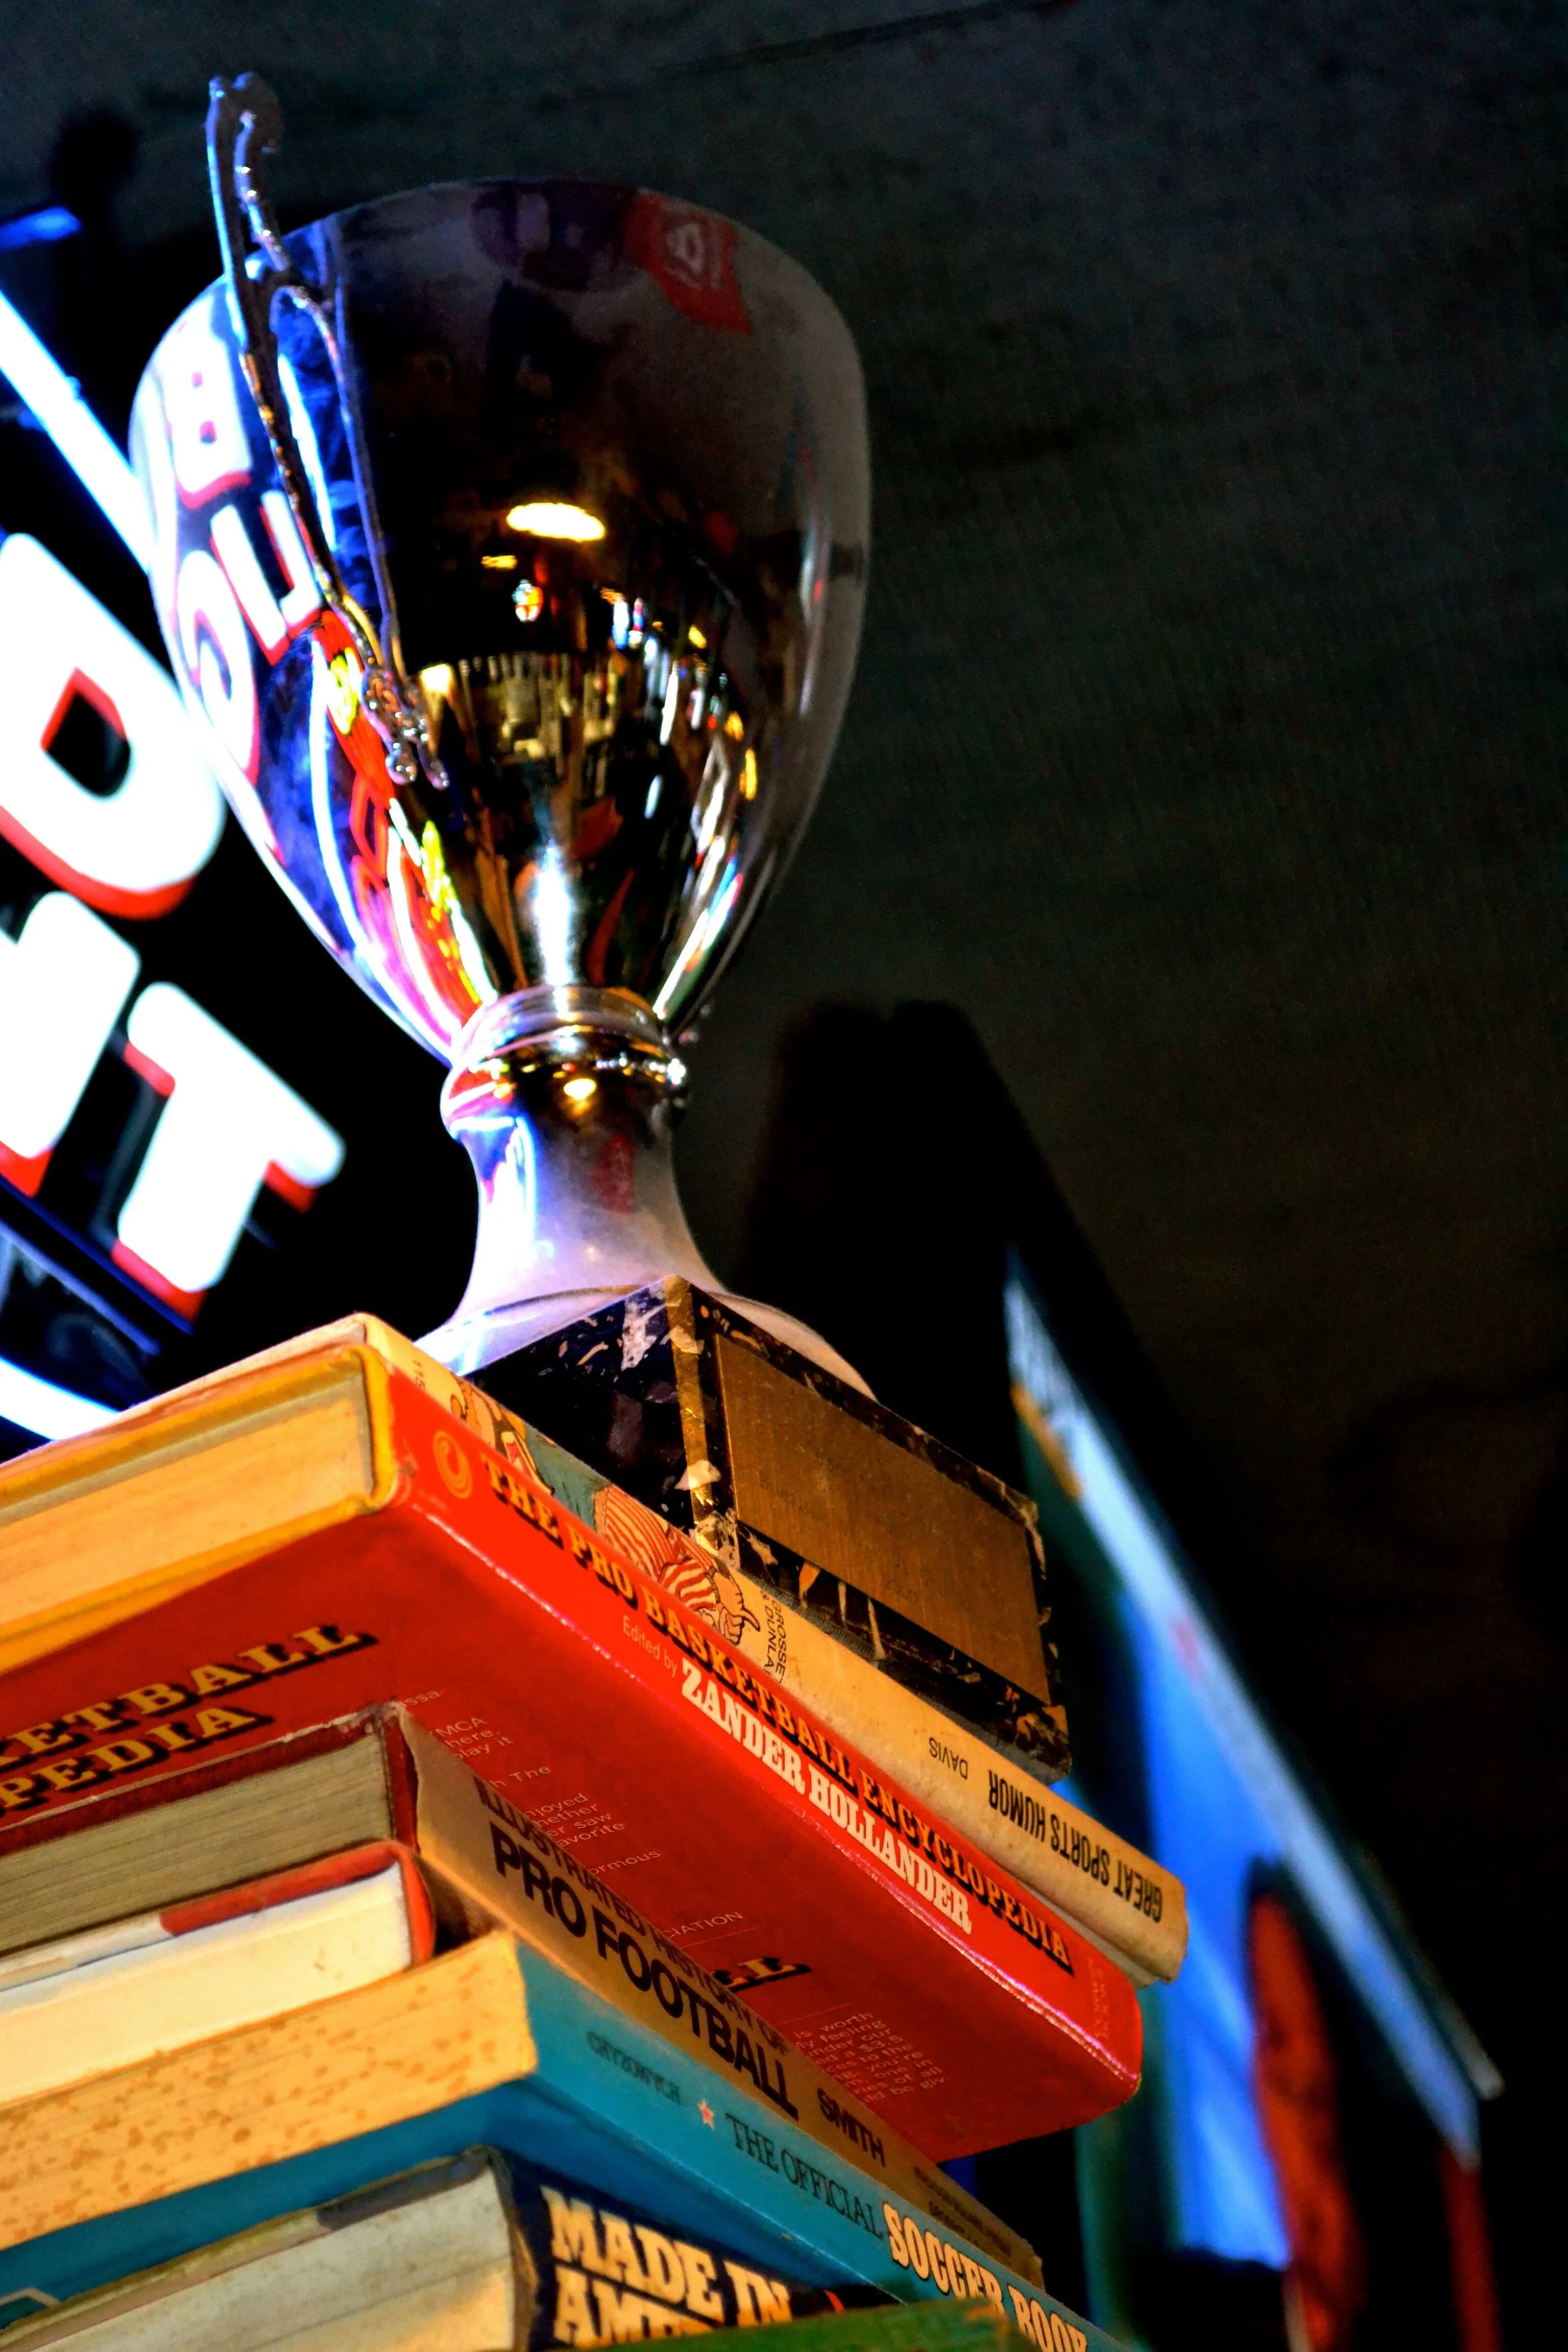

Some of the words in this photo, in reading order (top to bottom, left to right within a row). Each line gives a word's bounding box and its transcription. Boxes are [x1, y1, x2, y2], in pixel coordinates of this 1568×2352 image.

[623, 1614, 660, 1660] Edited
[664, 1650, 677, 1677] by
[0, 1625, 379, 1772] ETBALL
[429, 1717, 488, 1737] MCA
[480, 1453, 564, 1550] THE
[566, 1522, 638, 1611] PRO
[638, 1583, 859, 1798] BASKETBALL
[859, 1768, 1074, 1977] ENCYCLOPEDIA
[509, 1766, 551, 1782] The
[929, 1737, 968, 1780] DAVIS
[574, 1813, 612, 1829] saw
[682, 1657, 805, 1796] ZANDER
[808, 1764, 972, 1935] HOLLANDER
[988, 1769, 1046, 1843] HUMOR
[1051, 1813, 1110, 1887] SPORTS
[474, 1776, 647, 1937] ILLUSTRATED
[652, 1927, 754, 2029] HISTORY
[755, 2015, 790, 2054] OF
[1113, 1860, 1162, 1924] GREAT
[490, 1821, 587, 1938] PRO
[592, 1904, 798, 2121] FOOTBALL
[820, 2013, 873, 2032] worth
[820, 2020, 886, 2042] feeling
[859, 2054, 879, 2062] to
[881, 2045, 913, 2056] the
[862, 2028, 891, 2041] our
[874, 2067, 908, 2079] one
[914, 2059, 933, 2068] in
[889, 2085, 913, 2095] be
[894, 2074, 913, 2084] of
[920, 2067, 942, 2077] all
[817, 2087, 886, 2167] SMITH
[726, 2113, 778, 2173] THE
[781, 2149, 884, 2240] OFFICIAL
[540, 2185, 724, 2324] MADE
[724, 2259, 792, 2326] IN
[883, 2201, 1005, 2314] SOCCER
